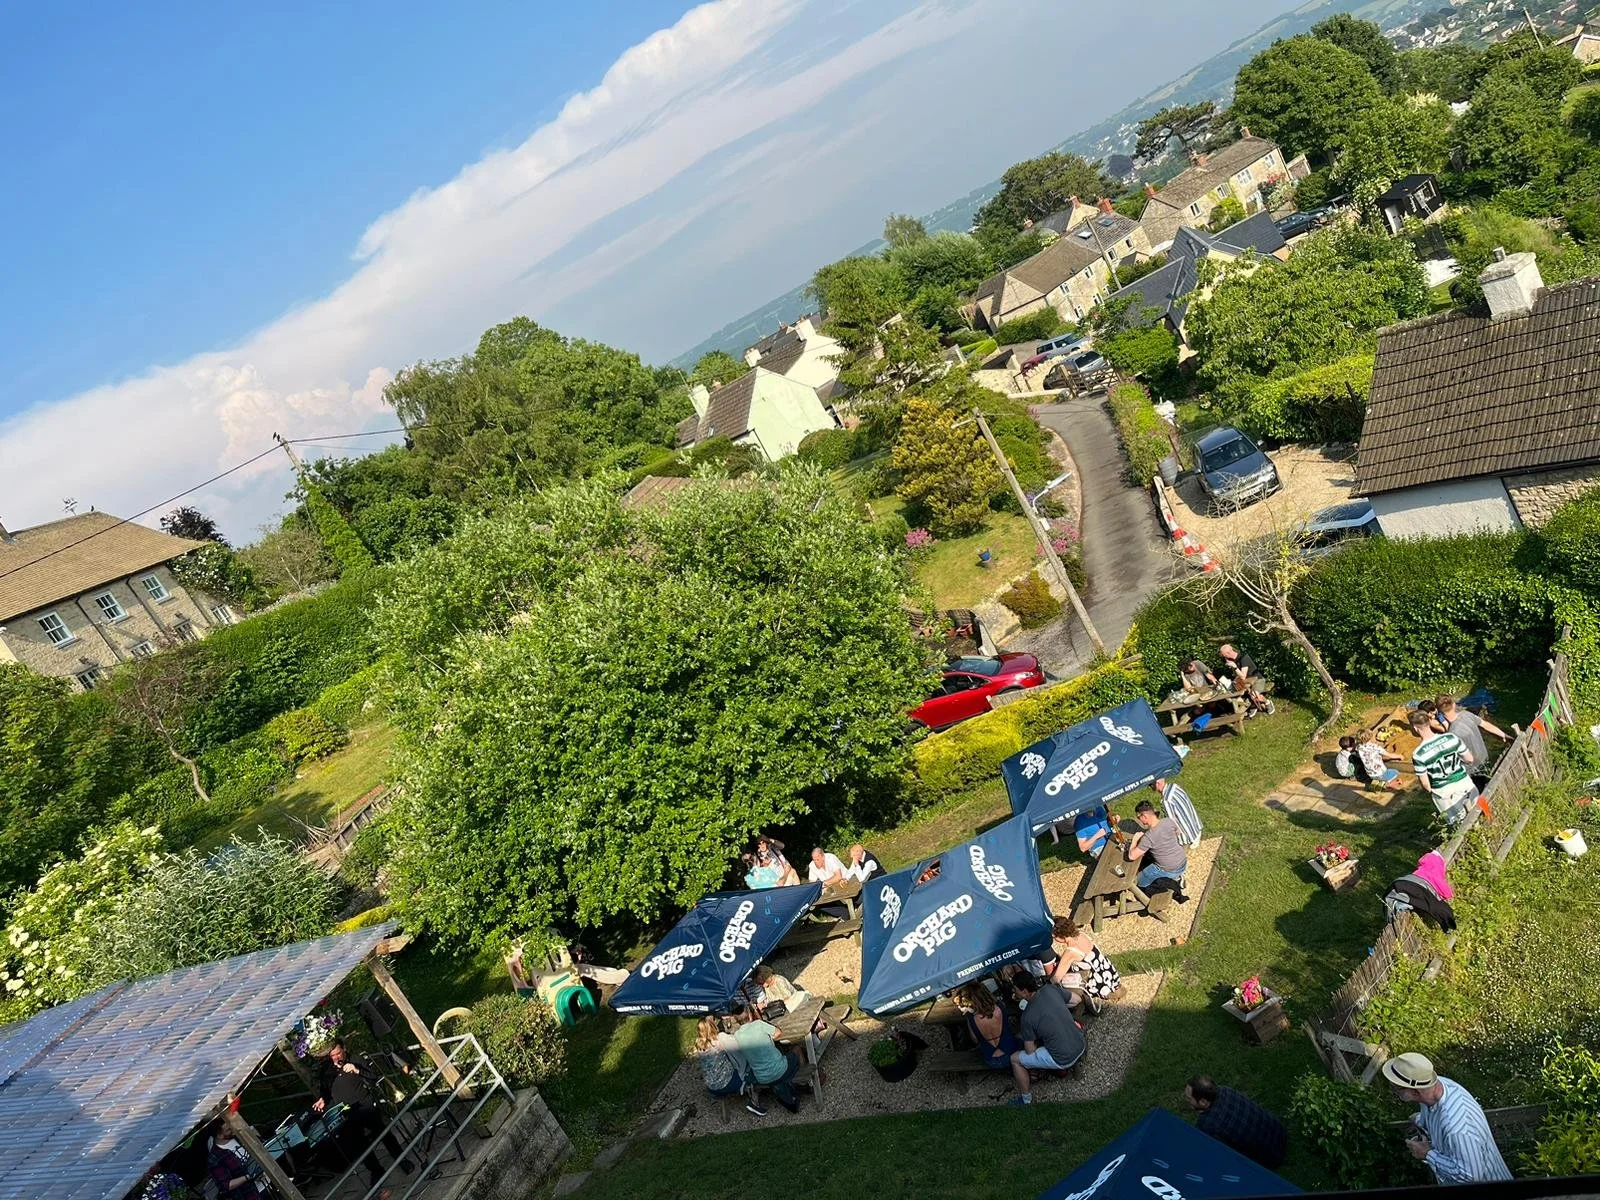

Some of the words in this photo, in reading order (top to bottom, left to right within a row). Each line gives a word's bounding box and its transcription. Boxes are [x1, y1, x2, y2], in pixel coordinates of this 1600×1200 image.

[1045, 741, 1111, 796] ORCHARD
[1068, 762, 1098, 790] PIG
[1437, 752, 1457, 777] 17
[969, 844, 1013, 902] ORCHARD
[987, 864, 1015, 888] PIG
[719, 900, 754, 963] ORCHARD
[735, 921, 757, 950] PIG
[893, 894, 973, 962] ORCHARD
[922, 921, 957, 957] PIG
[641, 943, 704, 978] ORCHARD
[657, 958, 684, 981] PIG
[956, 962, 984, 979] PREMIUM
[984, 953, 1002, 967] APPLE
[1002, 948, 1020, 960] CIDER
